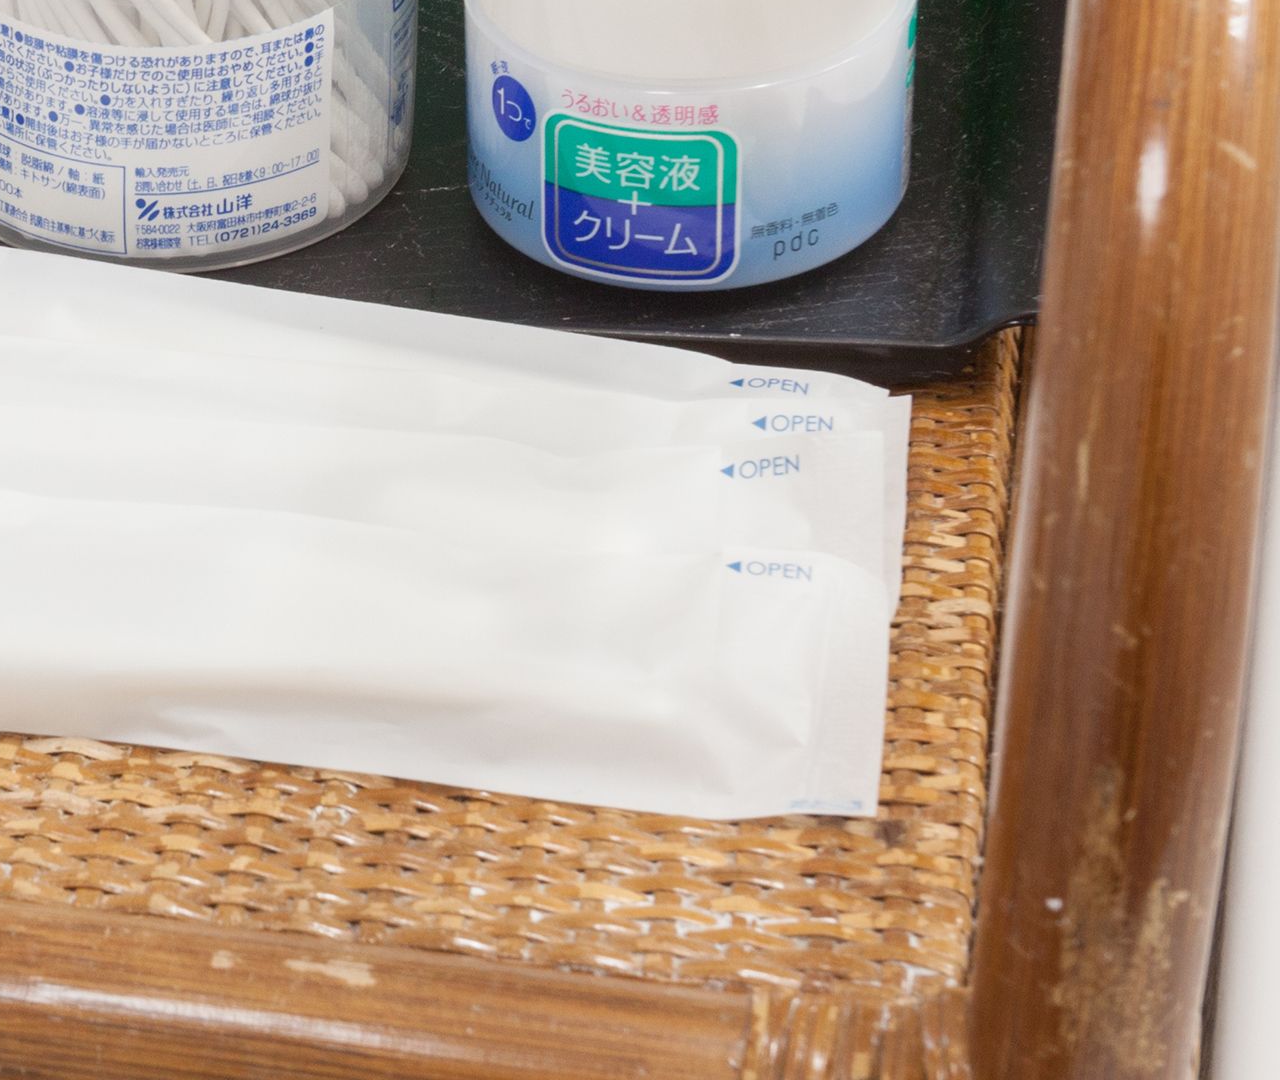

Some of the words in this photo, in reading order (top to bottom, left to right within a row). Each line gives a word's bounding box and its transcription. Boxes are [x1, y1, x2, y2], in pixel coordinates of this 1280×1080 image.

[574, 142, 701, 192] 美容液
[480, 163, 534, 220] Natural
[573, 213, 699, 256] クリーム
[773, 228, 819, 260] pdc
[747, 377, 809, 395] OPEN
[771, 414, 834, 432] OPEN
[739, 454, 801, 479] OPEN
[746, 561, 813, 582] OPEN
